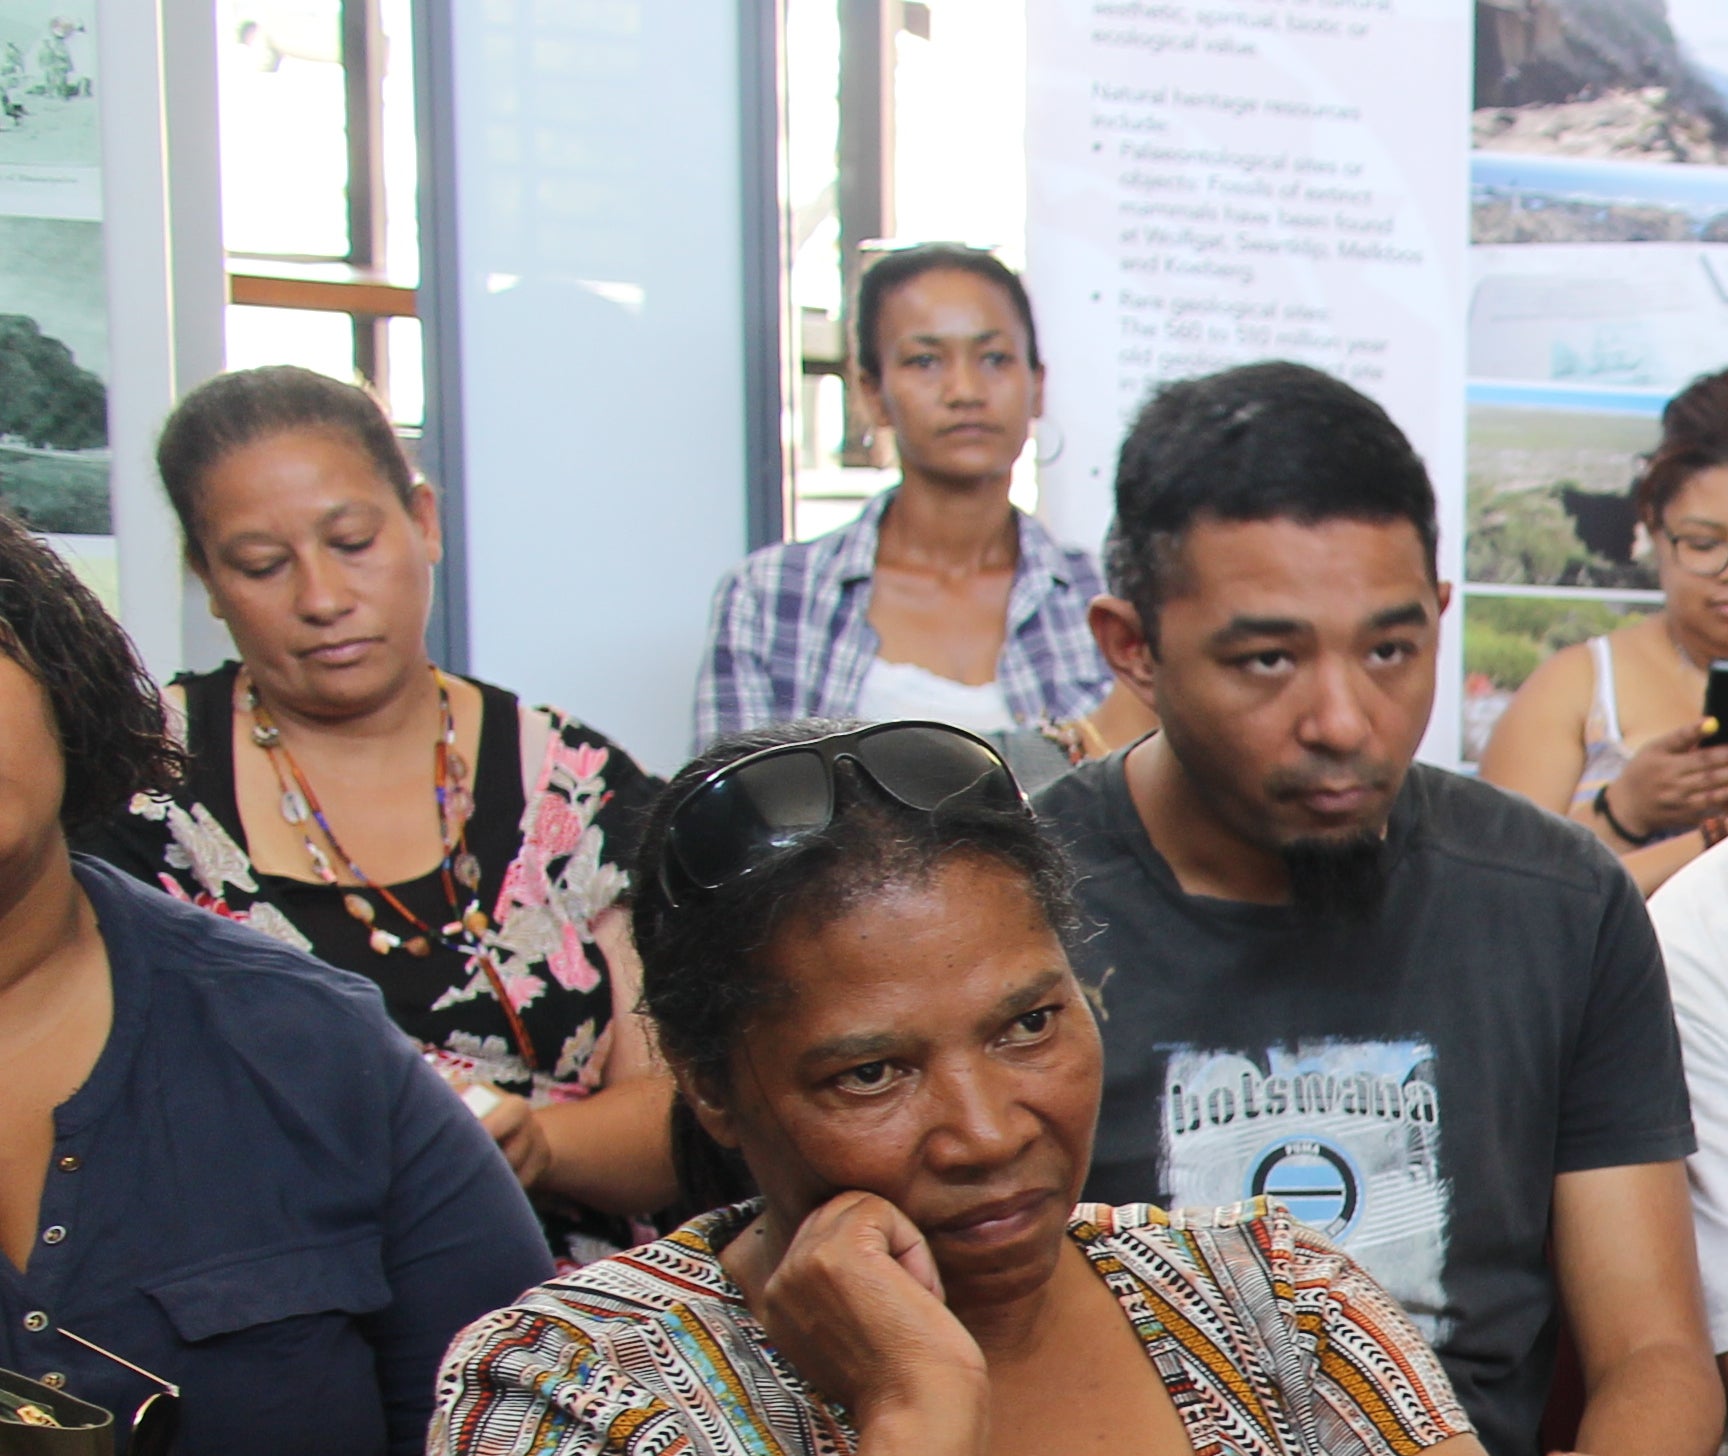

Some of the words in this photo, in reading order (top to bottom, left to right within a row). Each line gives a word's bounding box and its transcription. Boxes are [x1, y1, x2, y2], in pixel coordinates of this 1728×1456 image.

[1091, 81, 1168, 105] Natural
[1172, 84, 1259, 119] heritage
[1263, 101, 1363, 122] resources
[1293, 156, 1337, 175] sites
[1206, 174, 1273, 197] Fossils
[1223, 206, 1270, 225] have
[1277, 209, 1330, 229] been
[1333, 212, 1394, 235] found
[1119, 255, 1159, 273] and
[1170, 294, 1277, 319] geological
[1120, 314, 1158, 336] The
[1170, 1068, 1438, 1136] botswana
